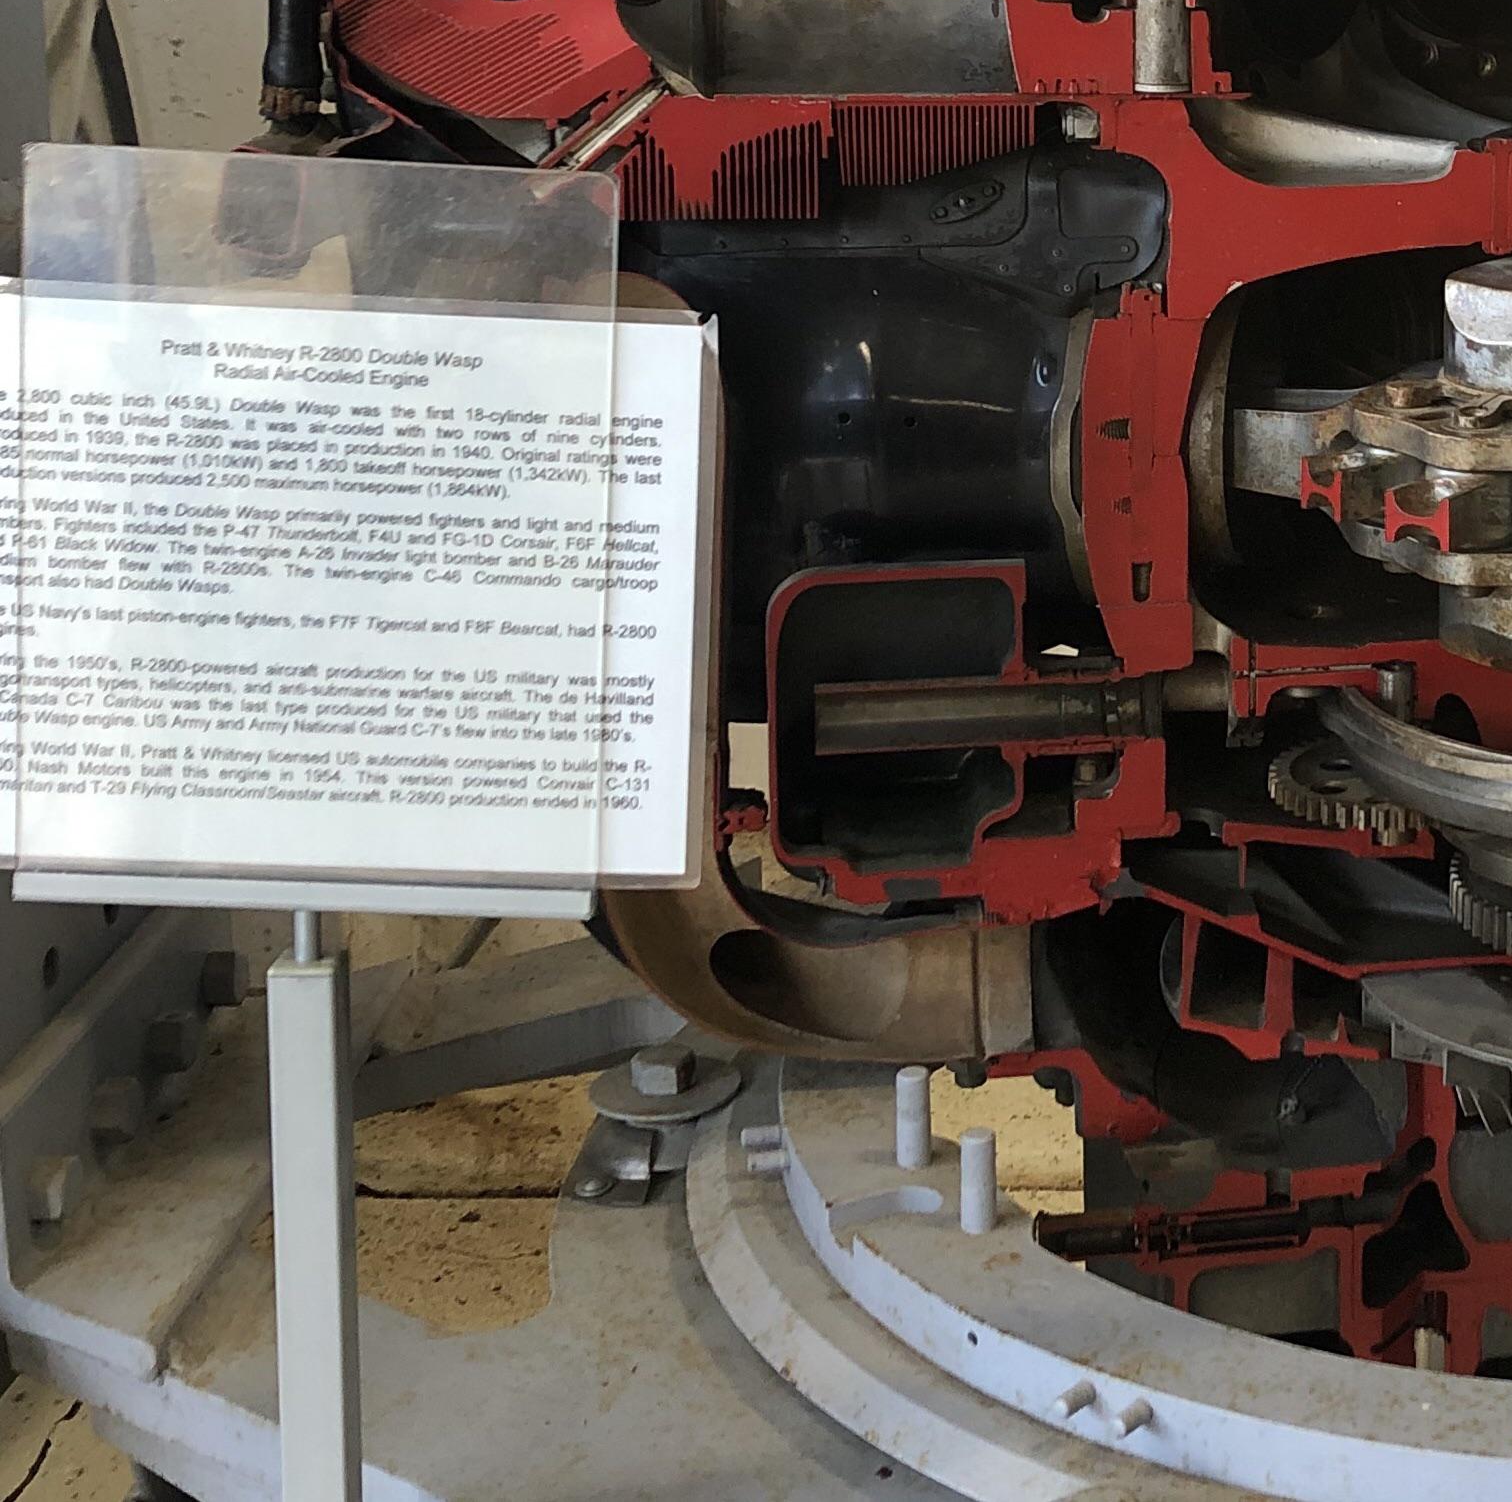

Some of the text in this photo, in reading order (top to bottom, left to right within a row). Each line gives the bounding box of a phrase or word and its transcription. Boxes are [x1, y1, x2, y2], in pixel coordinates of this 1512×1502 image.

[160, 340, 202, 356] Pratt
[224, 343, 295, 363] Whitney
[299, 346, 363, 363] R-2800
[368, 349, 429, 366] Double
[434, 352, 484, 371] Wasp
[213, 364, 430, 391] Radial Air-Cooled Engine
[70, 392, 112, 407] cubic
[122, 394, 155, 408] inch
[229, 399, 286, 414] Double
[296, 401, 341, 419] Wasp
[351, 406, 381, 418] was
[391, 406, 416, 419] the
[426, 406, 455, 421] first
[466, 407, 549, 427] 18-cylinder
[559, 412, 601, 427] radial
[611, 415, 664, 432] engine
[59, 411, 73, 423] in
[83, 411, 109, 425] the
[120, 413, 170, 428] United
[266, 422, 298, 433] was
[308, 421, 384, 437] air-cooled
[395, 424, 426, 438] with
[436, 426, 464, 440] two
[474, 429, 511, 442] rows
[521, 428, 537, 443] of
[546, 431, 580, 445] nine
[64, 431, 78, 443] in
[134, 433, 160, 446] the
[166, 433, 224, 450] R-2800
[230, 439, 261, 450] was
[267, 438, 318, 456] placed
[345, 442, 425, 460] production
[431, 445, 446, 458] in
[501, 447, 561, 466] Original
[567, 451, 618, 468] ratings
[624, 455, 663, 466] were
[25, 447, 79, 463] normal
[85, 450, 177, 469] horsepower
[268, 457, 298, 471] and
[353, 460, 407, 476] takeoff
[412, 464, 502, 482] horsepower
[599, 470, 629, 484] The
[634, 471, 663, 485] last
[61, 469, 127, 483] versions
[130, 470, 203, 490] produced
[333, 480, 423, 498] horsepower
[32, 497, 79, 513] World
[84, 499, 118, 515] War
[143, 503, 169, 517] the
[174, 503, 230, 519] Double
[236, 506, 280, 523] Wasp
[357, 511, 423, 529] powered
[428, 513, 486, 532] fighters
[491, 516, 521, 530] and
[527, 518, 558, 535] light
[564, 519, 593, 533] and
[599, 519, 661, 535] medium
[53, 517, 117, 537] Fighters
[123, 521, 187, 536] included
[223, 524, 260, 538] P-47
[407, 532, 436, 546] and
[54, 536, 98, 552] Black
[168, 540, 198, 556] The
[405, 550, 437, 568] light
[443, 551, 502, 567] bomber
[508, 554, 537, 567] and
[585, 556, 662, 572] Marauder
[47, 574, 81, 589] also
[84, 576, 114, 590] had
[118, 576, 173, 592] Double
[48, 556, 108, 571] bomber
[284, 564, 314, 578] The
[473, 571, 562, 587] Commando
[96, 607, 123, 621] last
[128, 609, 231, 628] piston-engine
[329, 614, 358, 629] F7F
[368, 616, 428, 635] Tigercat
[568, 624, 596, 638] had
[602, 624, 658, 639] R-2800
[474, 669, 498, 684] US
[506, 671, 559, 690] military
[605, 674, 656, 693] mostly
[66, 692, 655, 725] C-7 produced US military that used the
[526, 689, 553, 704] The
[559, 691, 578, 705] de
[584, 691, 655, 707] Havilland
[35, 710, 79, 728] Wasp
[171, 715, 212, 732] Army
[550, 728, 578, 741] late
[31, 742, 77, 756] World
[83, 743, 115, 757] War
[141, 744, 177, 759] Pratt
[454, 756, 536, 774] companies
[562, 759, 598, 773] build
[604, 760, 628, 774] the
[28, 759, 68, 775] Nash
[78, 761, 131, 777] Motors
[218, 767, 270, 784] engine
[359, 770, 388, 785] This
[463, 775, 528, 792] powered
[537, 776, 595, 791] Convair
[605, 778, 650, 794] C-131
[130, 781, 177, 800] Flying
